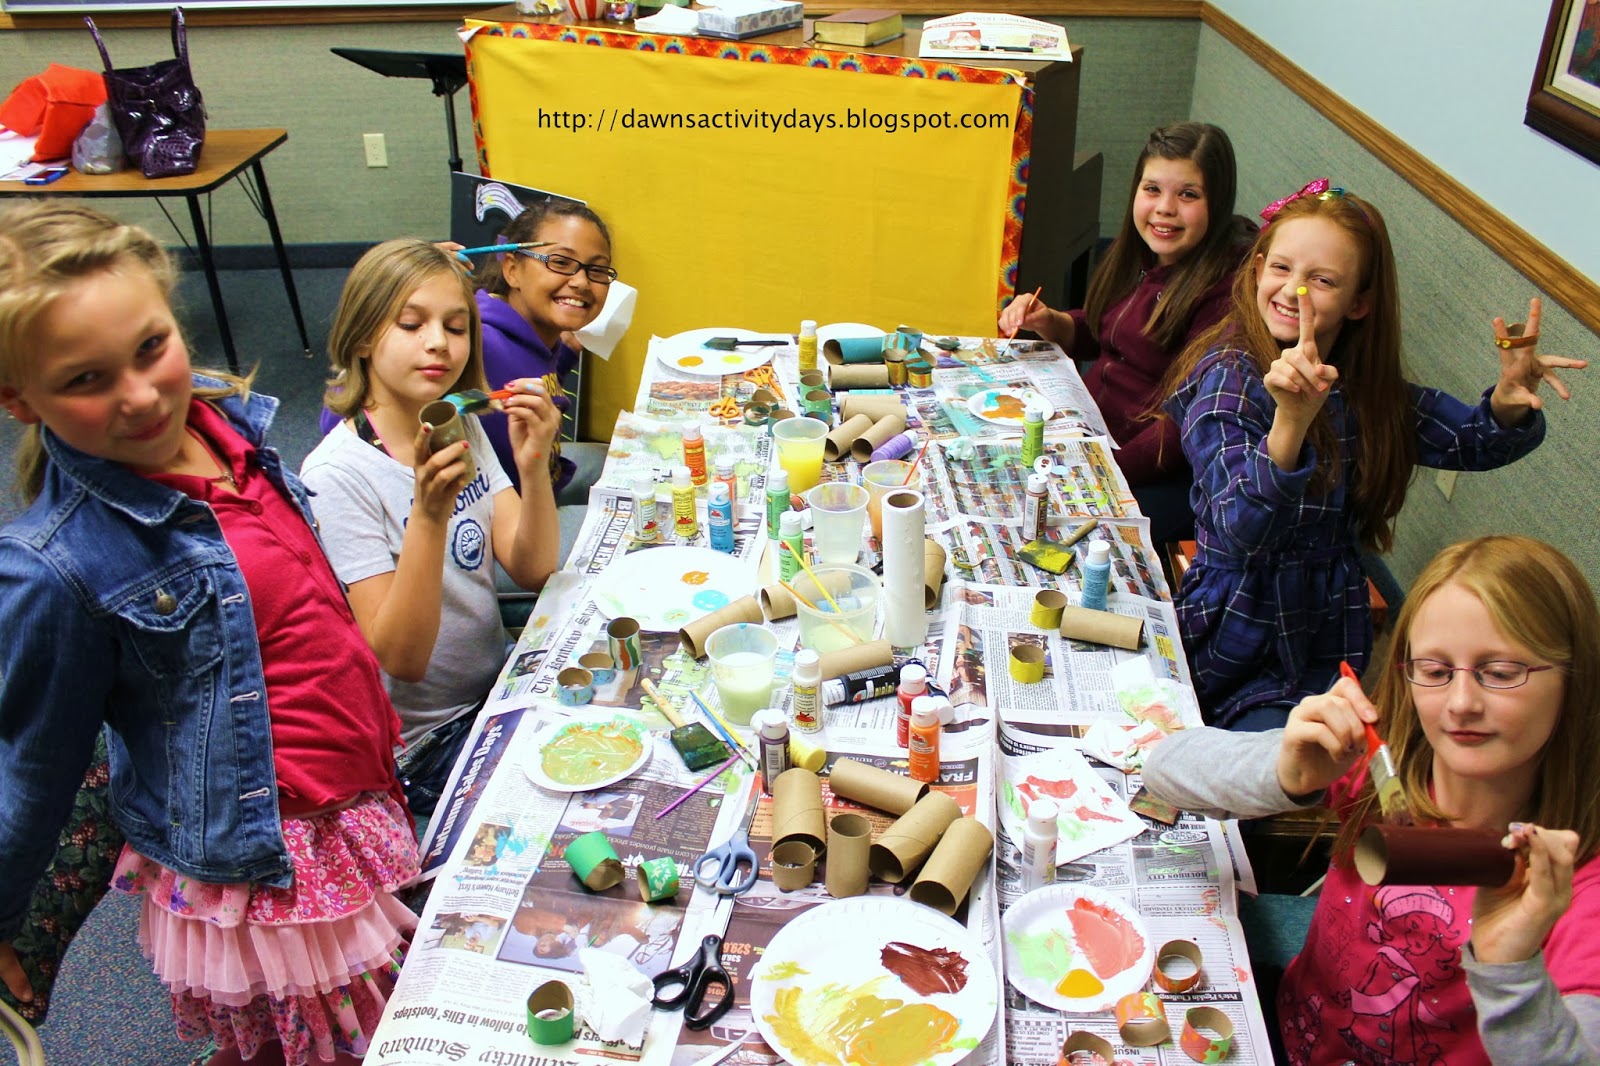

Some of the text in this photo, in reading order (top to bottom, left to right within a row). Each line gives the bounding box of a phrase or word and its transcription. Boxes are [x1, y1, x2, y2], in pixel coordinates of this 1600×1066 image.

[587, 500, 632, 574] BREAKING NEWS!
[531, 674, 555, 694] The
[545, 630, 582, 671] Kentucky
[432, 724, 503, 857] Autumn Sales Days
[606, 836, 629, 847] shocks
[629, 841, 656, 853] provides
[656, 847, 674, 856] maze
[675, 850, 690, 858] corn
[458, 882, 520, 898] Bethany Haven's first
[722, 942, 752, 956] $29,6
[721, 954, 742, 963] $36,0
[1192, 993, 1218, 1001] Pigskin
[392, 1006, 528, 1036] footsteps Ellis' in follow to
[379, 1036, 471, 1062] Standard
